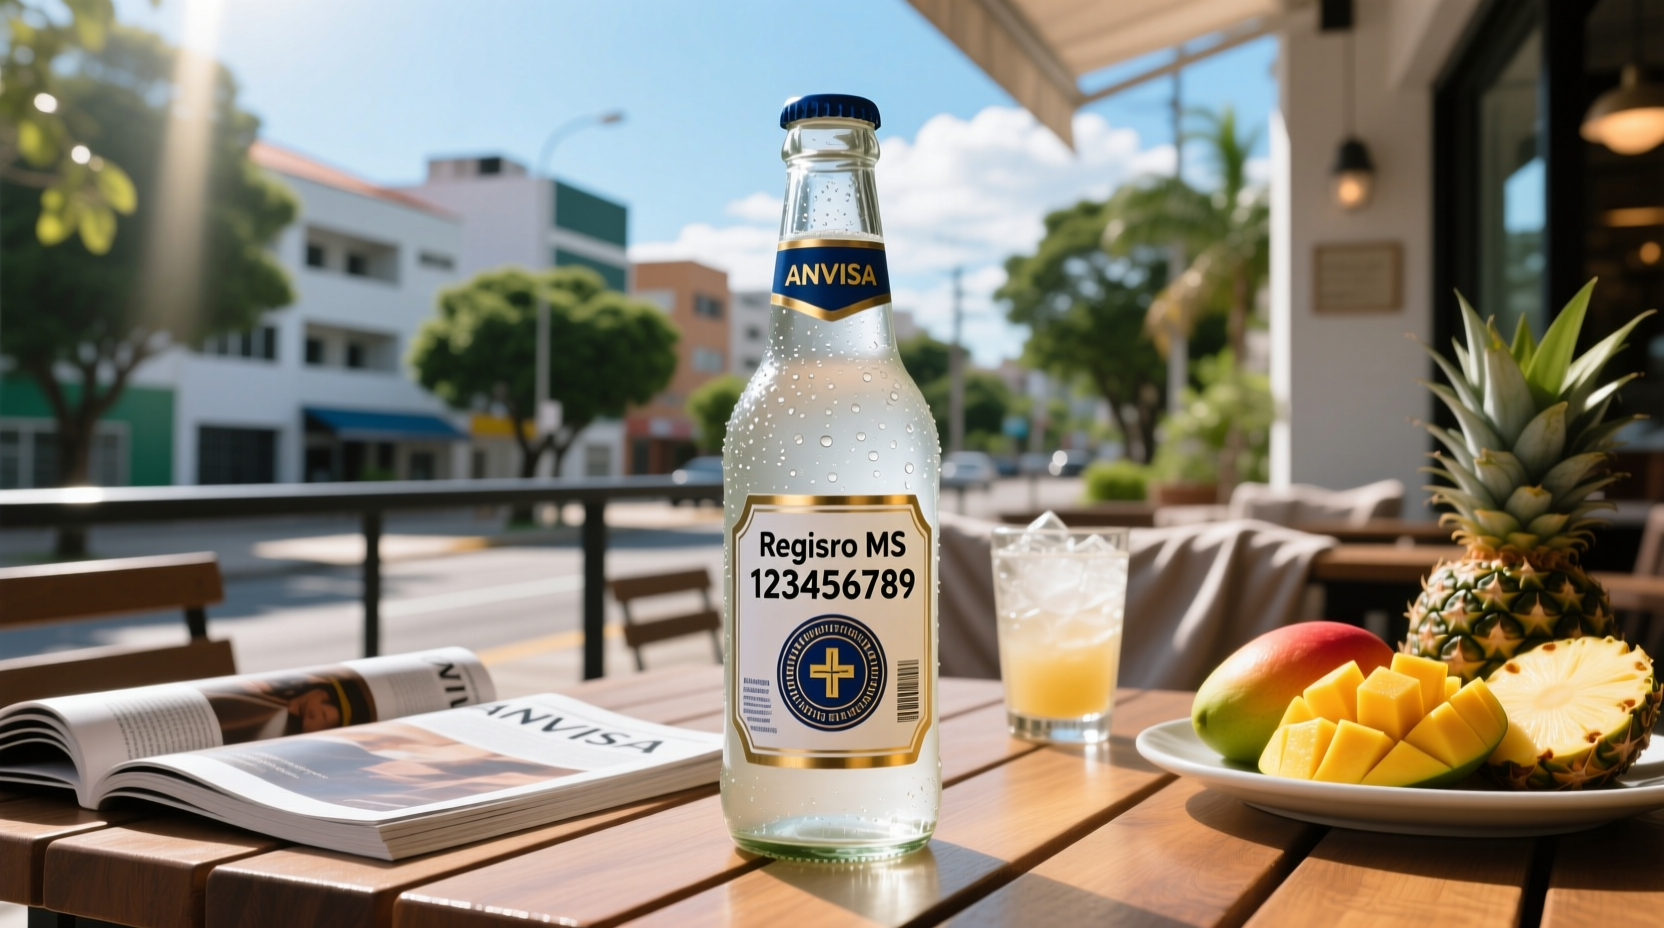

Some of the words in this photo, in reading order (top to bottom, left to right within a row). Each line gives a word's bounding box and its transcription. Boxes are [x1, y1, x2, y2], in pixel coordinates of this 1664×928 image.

[784, 262, 878, 287] ANVISA
[760, 531, 858, 565] Regisro
[866, 530, 907, 558] MS
[750, 568, 916, 600] 123456789
[476, 704, 664, 753] ANVISA
